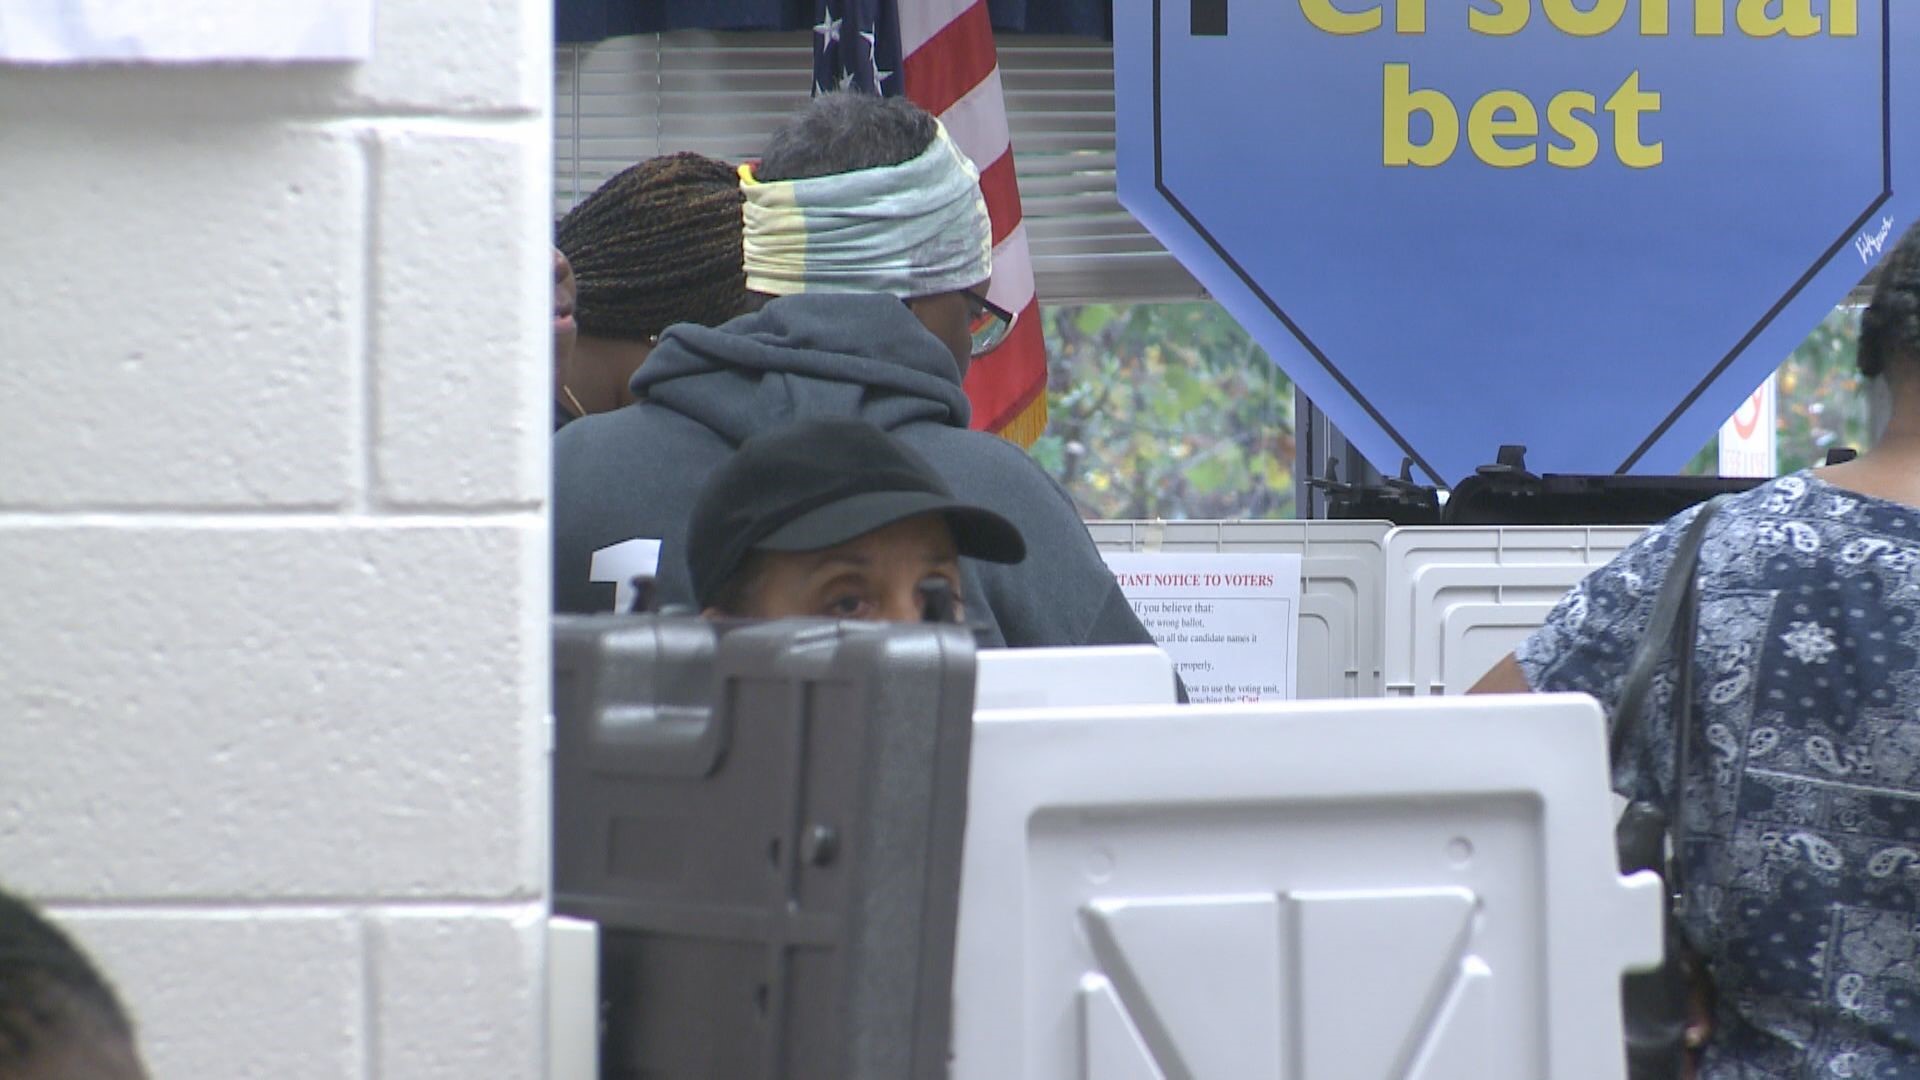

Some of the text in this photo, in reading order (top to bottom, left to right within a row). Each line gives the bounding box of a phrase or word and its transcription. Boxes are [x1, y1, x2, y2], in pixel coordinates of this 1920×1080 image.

[1382, 62, 1664, 168] best
[1154, 574, 1200, 587] NOTICE
[1203, 574, 1221, 587] TO
[1225, 574, 1273, 587] VOTERS
[1134, 601, 1142, 613] If
[1143, 604, 1160, 616] you
[1161, 601, 1193, 613] believe
[1143, 618, 1205, 630] the wrong ballot,
[1166, 633, 1176, 643] all
[1177, 633, 1188, 643] the
[1190, 633, 1225, 643] candidate
[1226, 634, 1250, 643] names
[1251, 633, 1257, 643] it
[1180, 659, 1215, 673] properly.
[1201, 684, 1209, 693] to
[1210, 685, 1223, 693] use
[1224, 683, 1236, 693] the
[1238, 683, 1261, 696] voting
